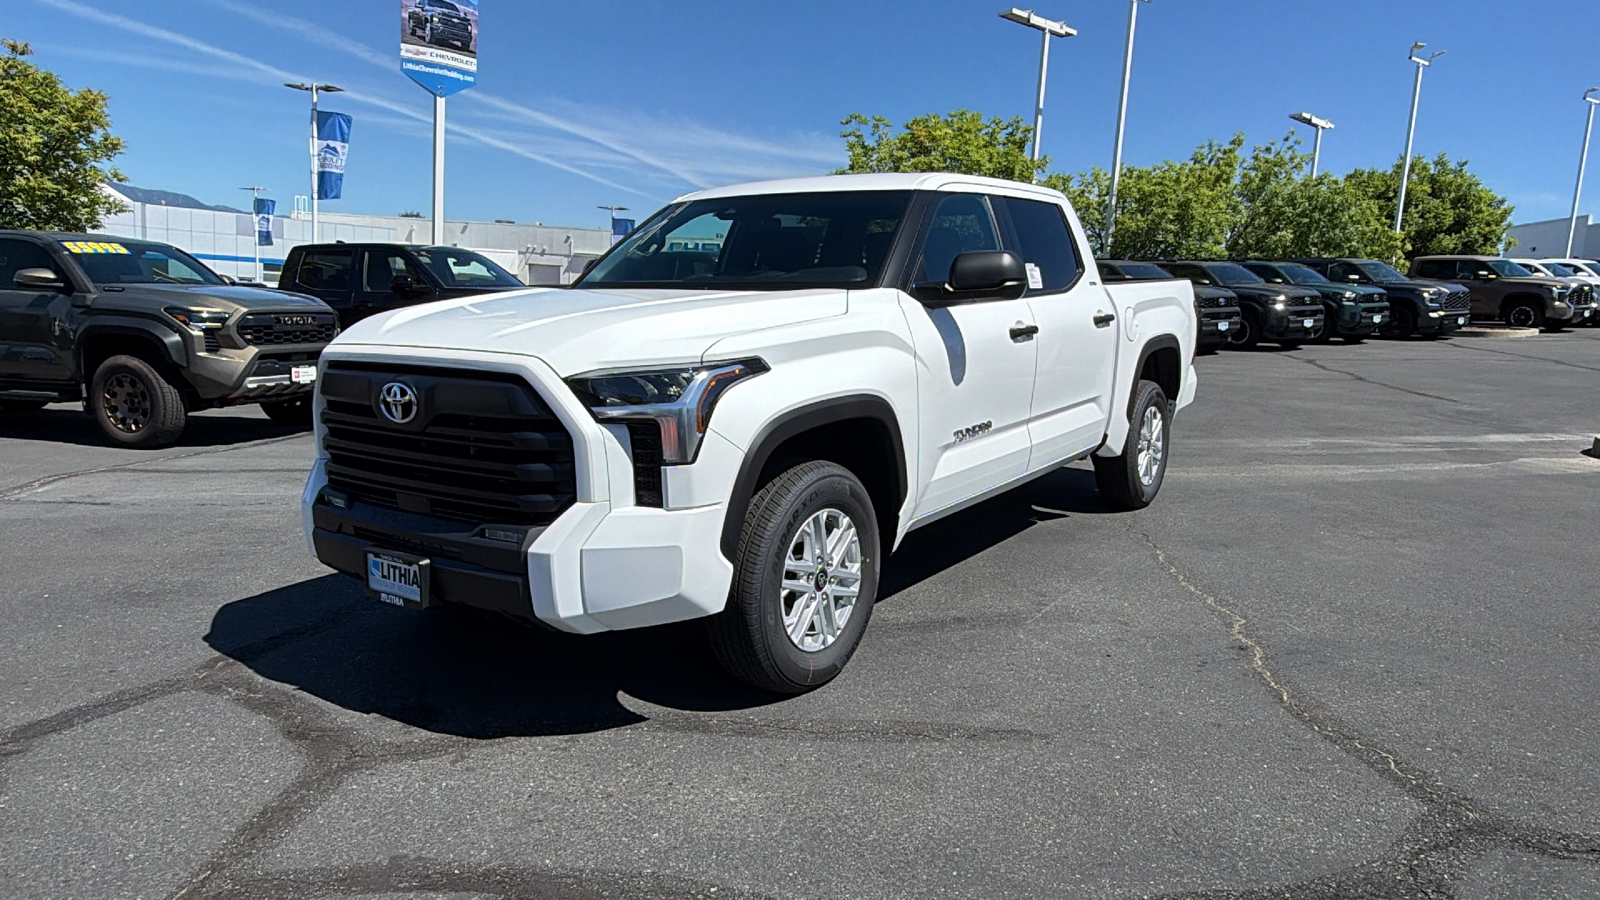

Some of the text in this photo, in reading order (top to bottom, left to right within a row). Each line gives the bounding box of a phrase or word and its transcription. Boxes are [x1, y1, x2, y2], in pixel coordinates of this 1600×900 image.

[429, 52, 473, 66] CHEVROLET
[403, 62, 474, 82] LithiaChevroletRedding.com
[279, 316, 314, 324] TOYOTA
[952, 419, 993, 444] TUNDRA
[381, 561, 421, 588] LITHIA
[386, 594, 404, 607] LITHIA
